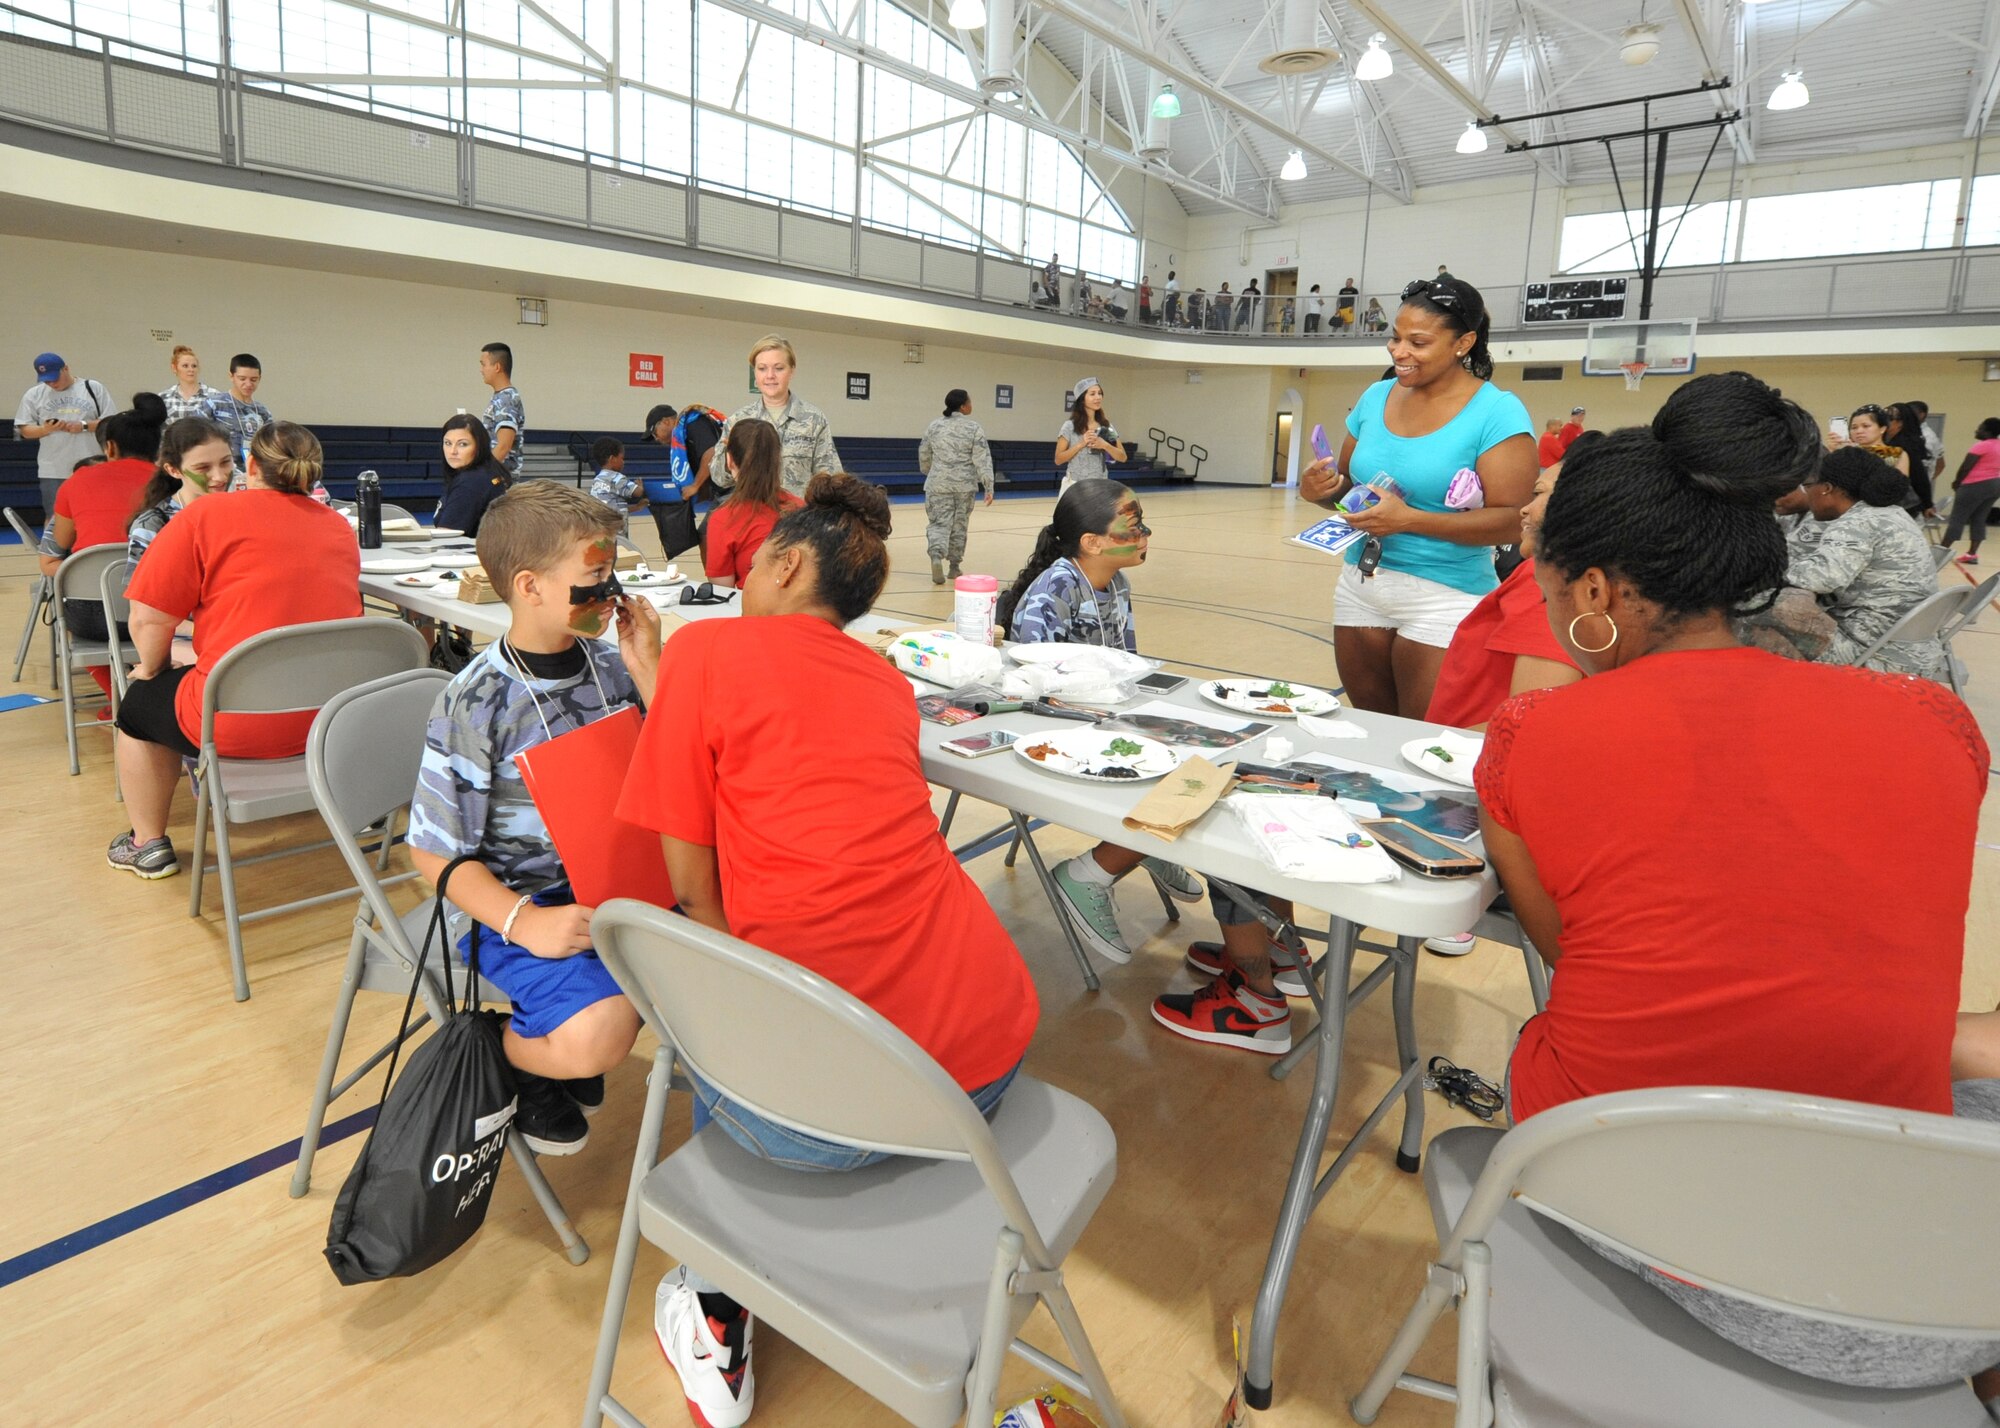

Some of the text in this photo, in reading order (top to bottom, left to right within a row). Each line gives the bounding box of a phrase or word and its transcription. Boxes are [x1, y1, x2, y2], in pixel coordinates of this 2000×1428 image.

[640, 360, 653, 371] RED
[635, 370, 658, 382] CHALK
[850, 377, 867, 386] BLACK
[850, 386, 867, 395] CHALK
